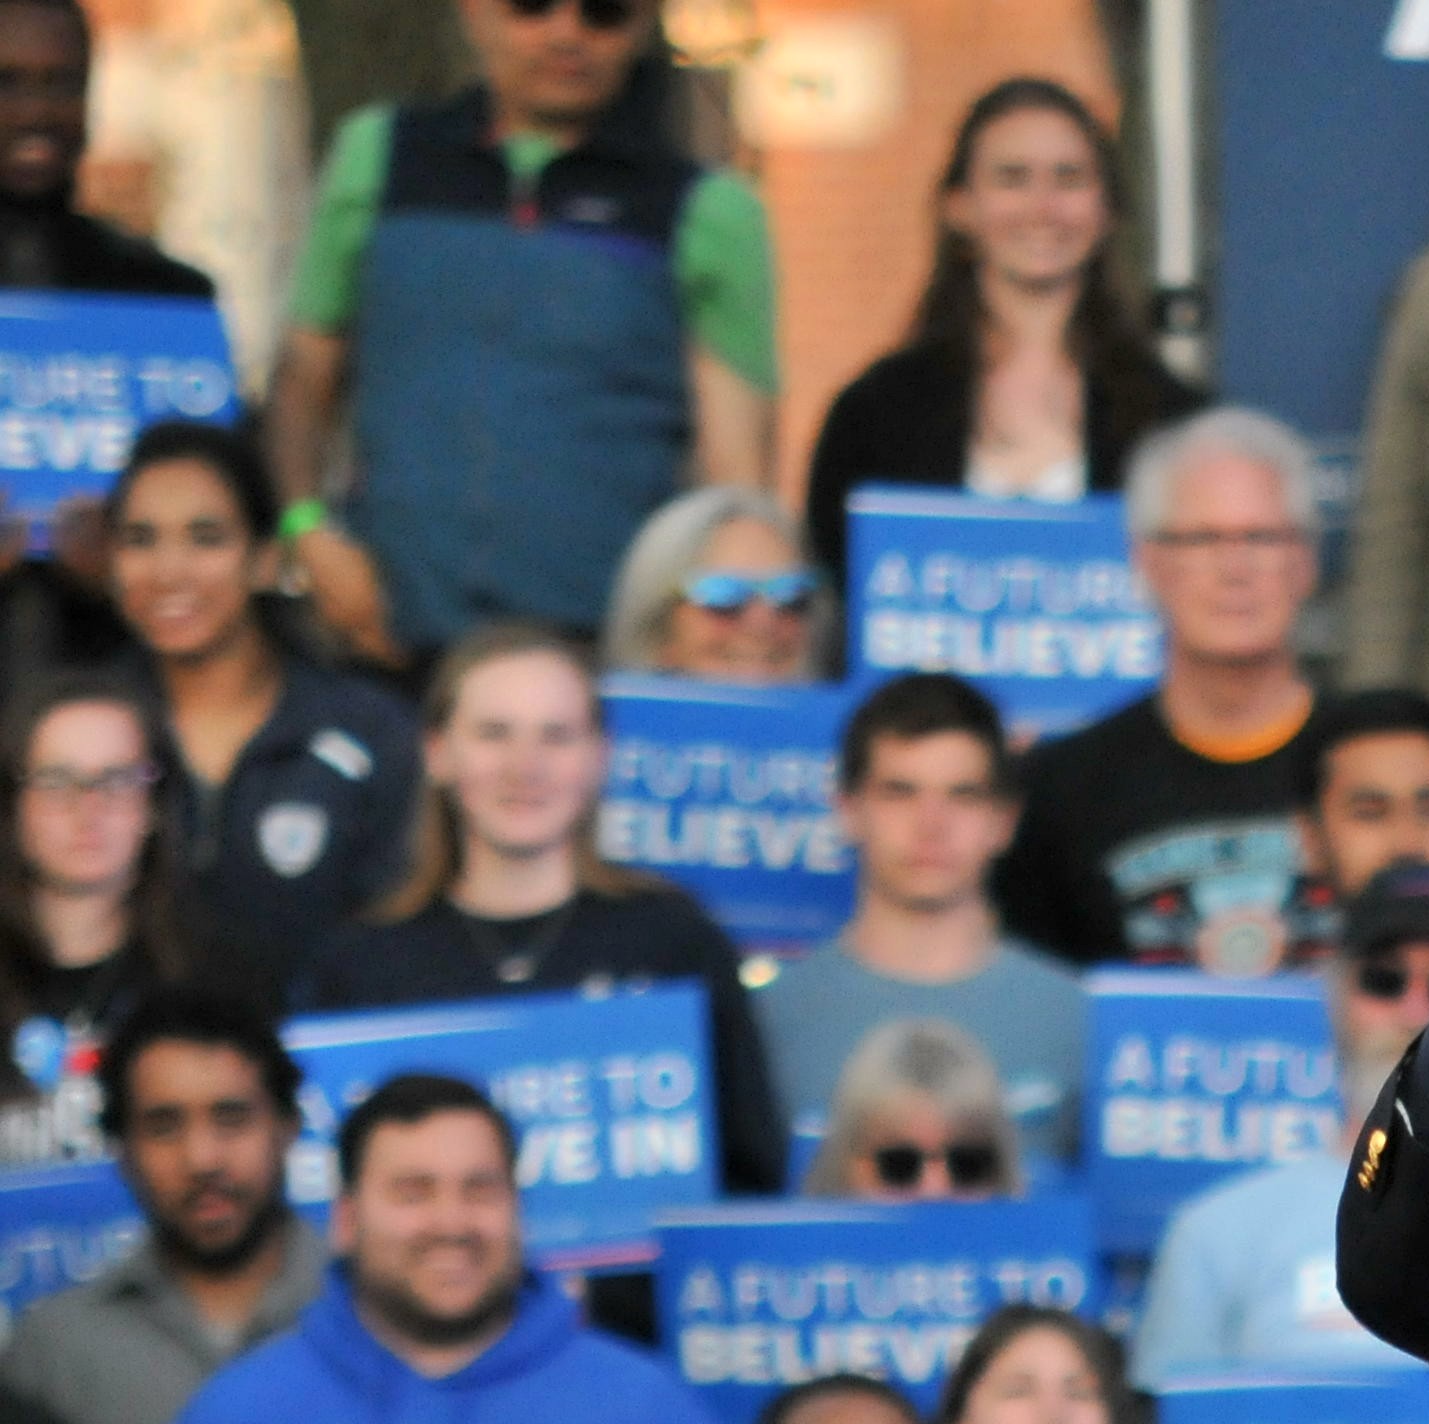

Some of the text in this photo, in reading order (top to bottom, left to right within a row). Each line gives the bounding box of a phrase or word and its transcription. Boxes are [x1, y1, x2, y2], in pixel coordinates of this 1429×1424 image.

[596, 798, 852, 875] ELIEVE
[603, 1052, 698, 1109] TO
[1109, 1034, 1336, 1098] A FUTU
[607, 1115, 700, 1180] IN
[1102, 1095, 1340, 1163] BELIE
[679, 1266, 723, 1320] A
[731, 1262, 981, 1320] FUTURE
